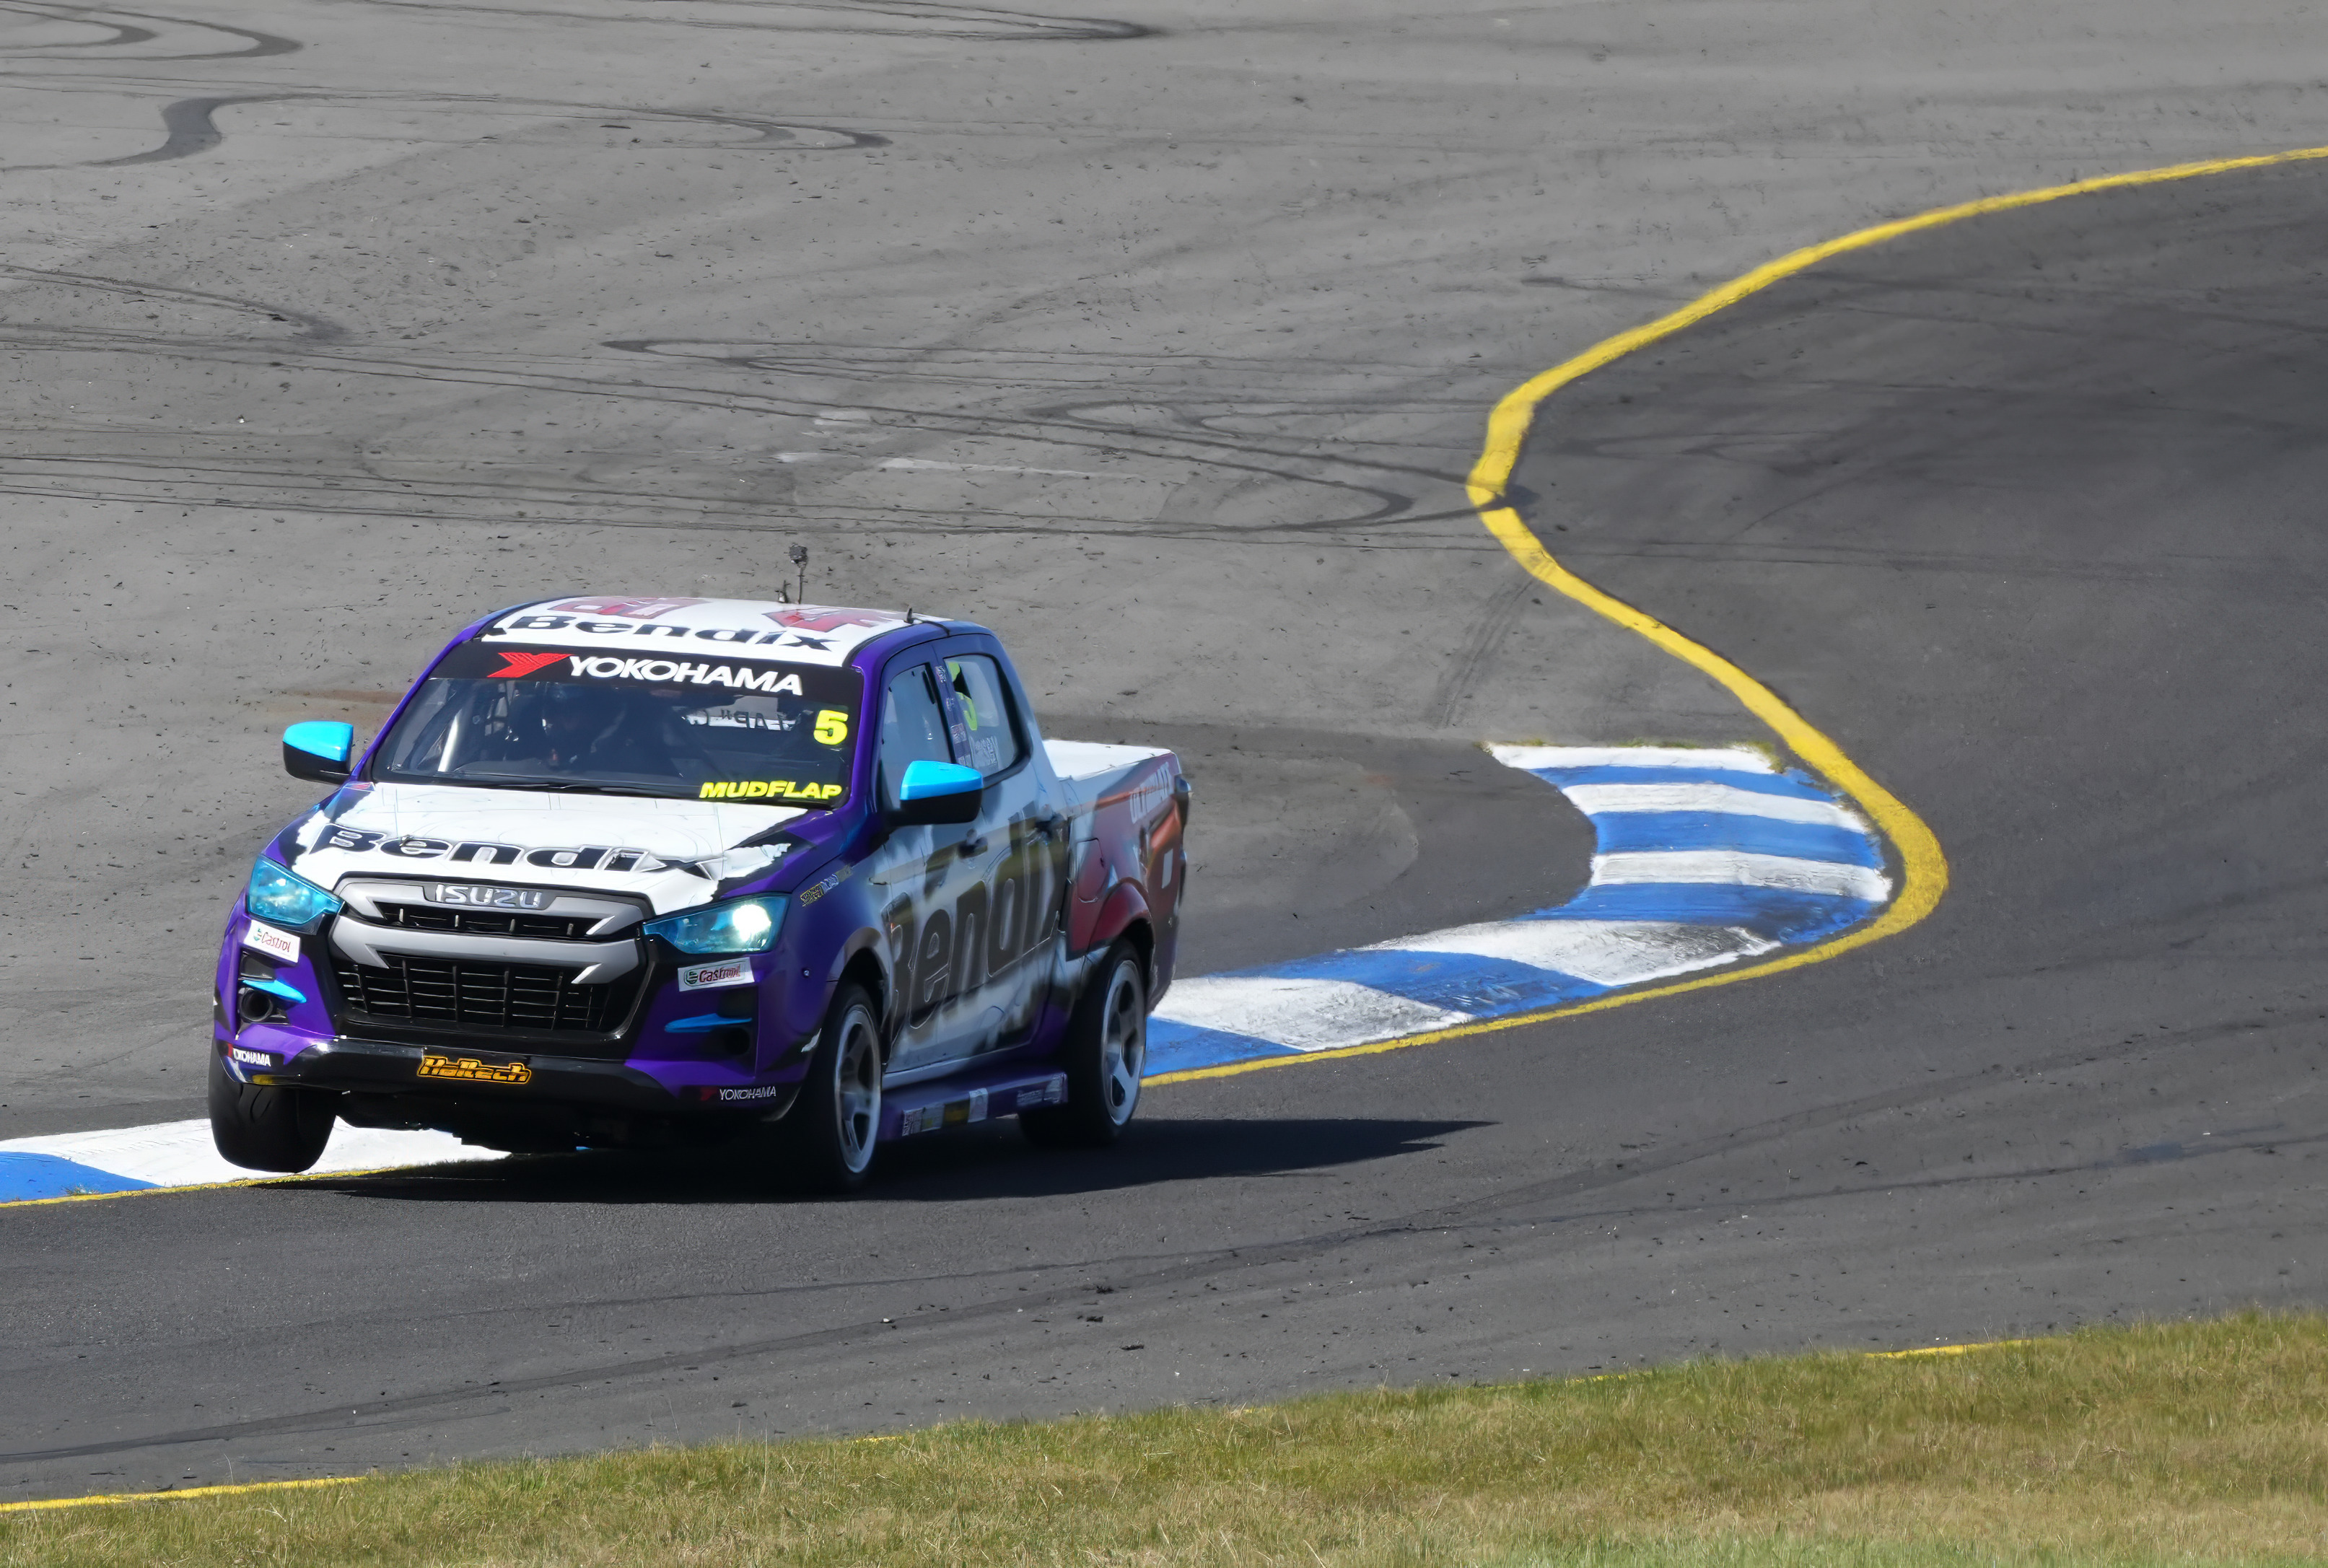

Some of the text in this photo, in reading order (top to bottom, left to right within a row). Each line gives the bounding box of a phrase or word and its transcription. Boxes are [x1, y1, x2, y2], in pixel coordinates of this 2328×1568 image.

[507, 616, 841, 652] Bendix
[569, 656, 803, 696] YOKOHAMA
[813, 710, 849, 745] 5
[699, 780, 843, 800] MUDFLAP
[309, 823, 725, 881] Bendix
[435, 883, 542, 908] ISUZU
[261, 932, 292, 952] Castrol
[699, 963, 741, 983] Castrol
[417, 1056, 532, 1084] Haltech
[719, 1086, 776, 1100] YOKOHAMA
